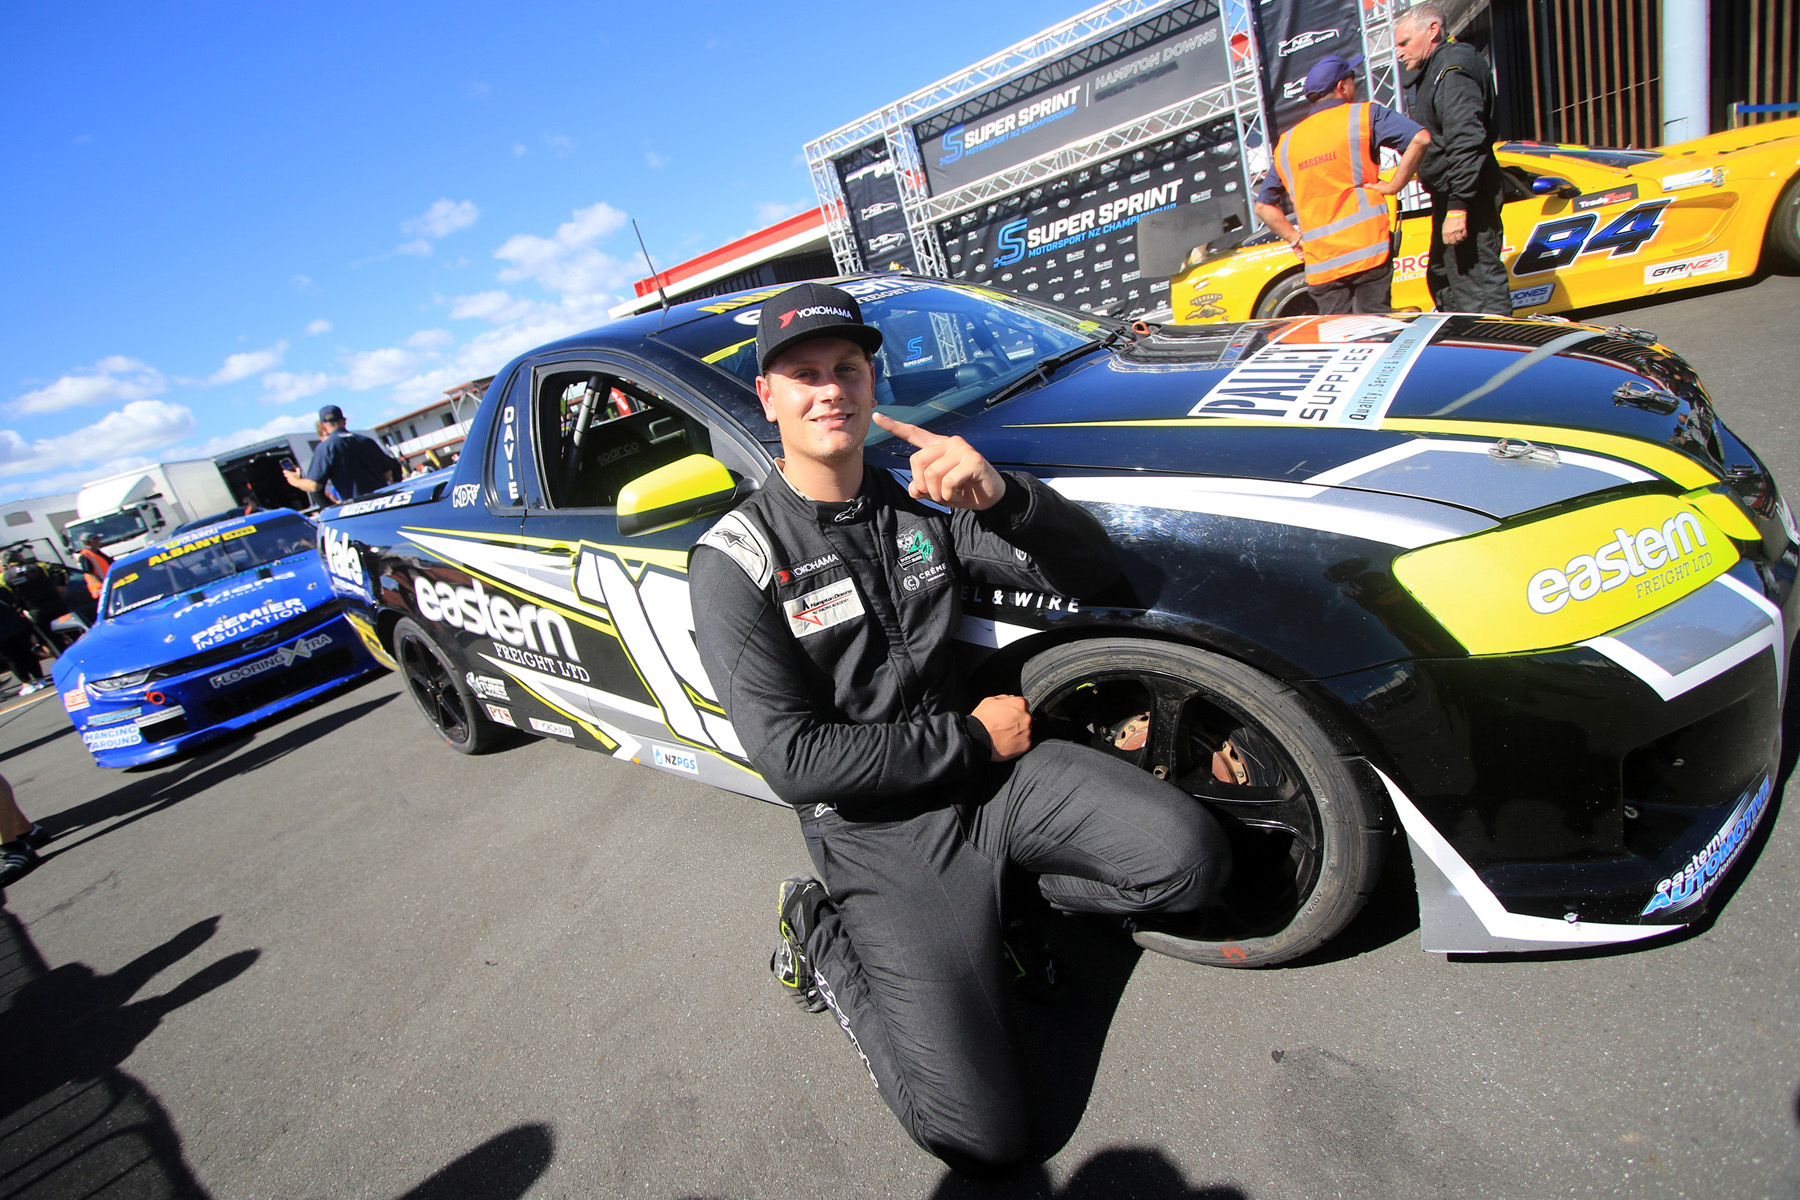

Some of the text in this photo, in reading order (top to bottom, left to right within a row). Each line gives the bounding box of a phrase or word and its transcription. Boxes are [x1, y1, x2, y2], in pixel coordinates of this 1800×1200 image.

[1095, 28, 1218, 91] HAMPTON DOWNS
[1292, 34, 1313, 47] NZ
[963, 85, 1081, 149] SUPER SPRINT
[965, 105, 1077, 157] MOTORSPORT NZ CHAMPIONSHIP
[1298, 151, 1338, 171] MARSHALL
[1027, 178, 1184, 249] SUPER SPRINT
[1579, 191, 1633, 209] TradeZone
[1028, 232, 1086, 258] MOTORSPORT
[1088, 226, 1102, 239] NZ
[1652, 258, 1713, 278] GTRNZ
[797, 305, 853, 320] YOKOHAMA
[1198, 346, 1374, 422] PALLET SUPPLIES
[503, 405, 519, 501] DAVIE
[596, 441, 641, 465] sparco
[148, 534, 221, 567] ALBANY
[325, 526, 364, 586] Yale
[791, 553, 840, 577] YOKOHAMA
[1527, 511, 1707, 615] eastern
[1636, 552, 1714, 598] FREIGHT LTD
[191, 597, 303, 645] PREMIER
[415, 577, 582, 663] eastern
[992, 590, 1004, 605] &
[1014, 589, 1081, 614] WIRE
[196, 604, 308, 651] INSULATION
[493, 642, 591, 684] FREIGHT LTD
[488, 705, 512, 722] PTS
[91, 737, 140, 751] AROUND
[665, 754, 696, 770] NZPGS
[1641, 774, 1771, 916] AUTOMOTIVE
[1656, 833, 1722, 893] eastern
